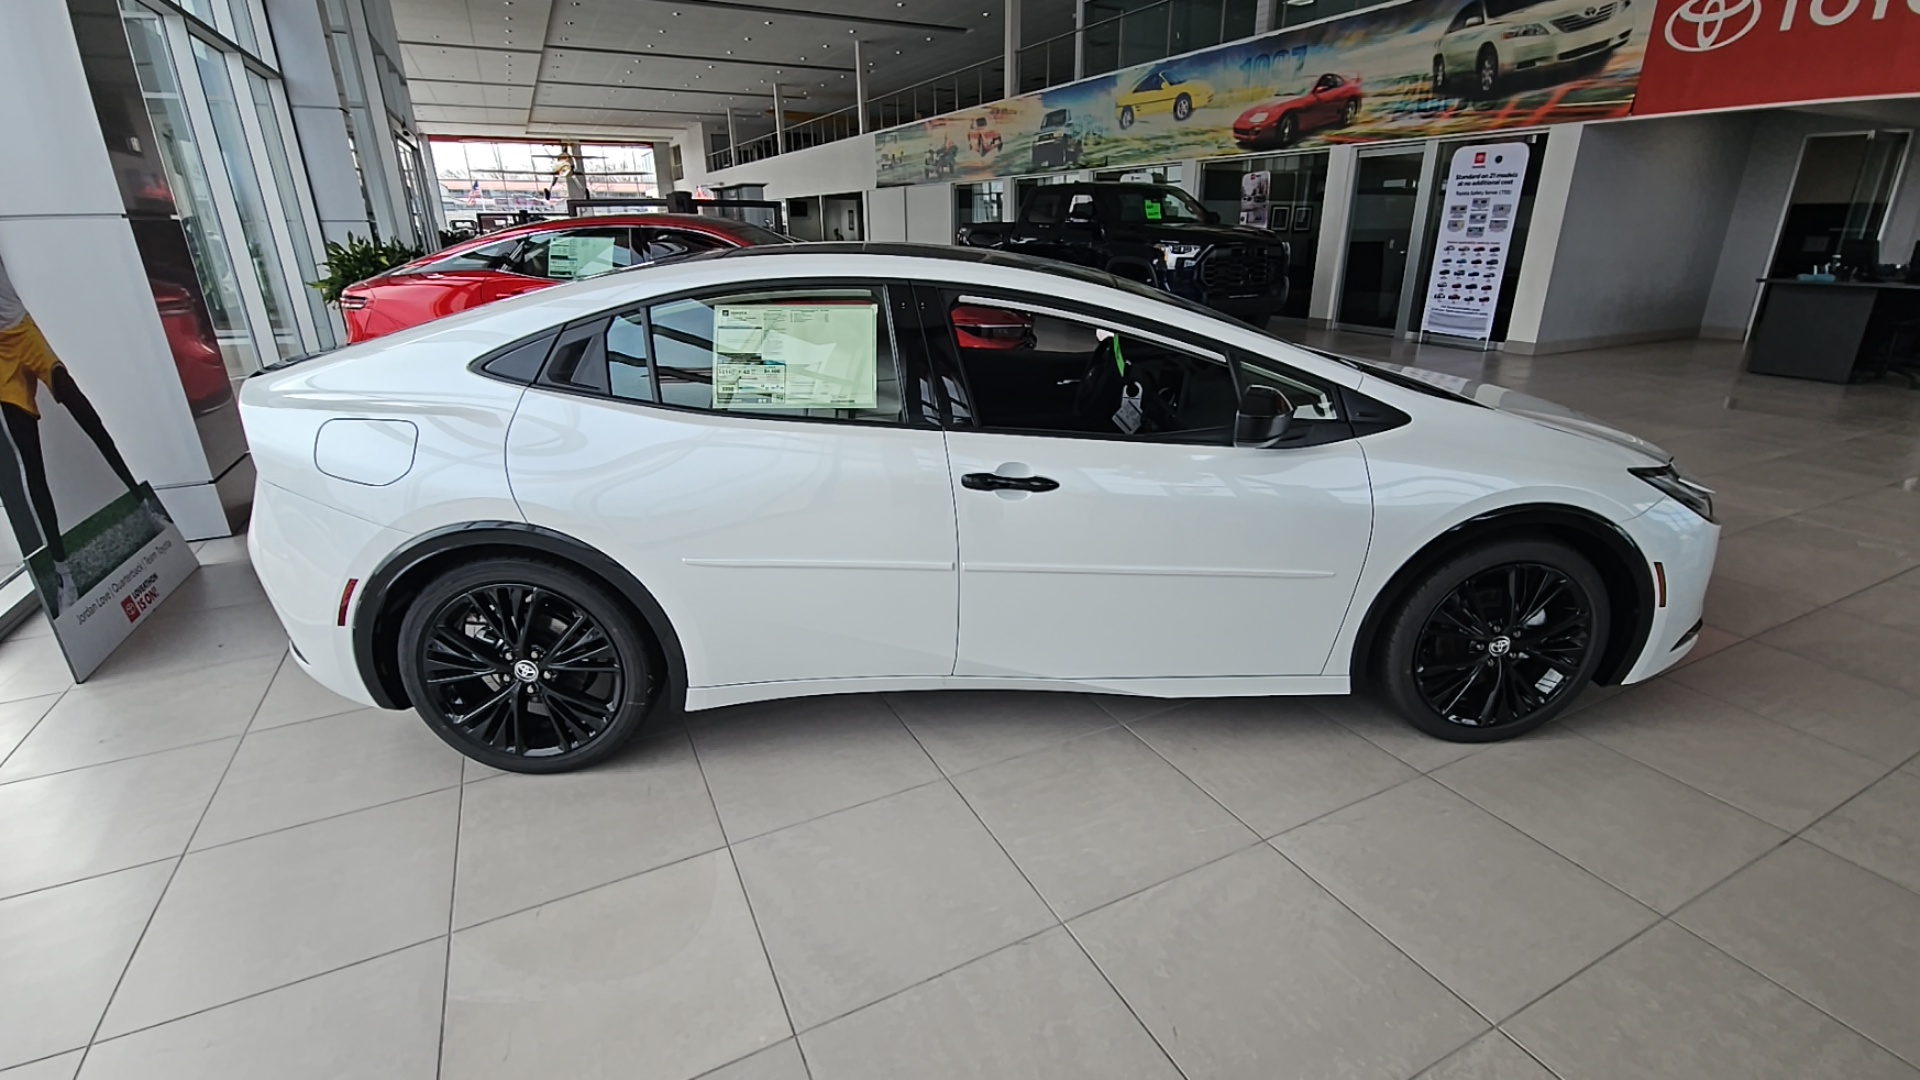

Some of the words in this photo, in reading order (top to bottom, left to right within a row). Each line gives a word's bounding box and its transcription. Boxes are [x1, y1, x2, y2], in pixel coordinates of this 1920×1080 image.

[76, 603, 98, 625] Jordan
[95, 592, 112, 608] Love
[111, 564, 144, 593] Quarterback
[143, 552, 157, 565] Team
[155, 540, 172, 555] Toyota
[131, 572, 159, 599] LOVEATHON
[137, 598, 147, 612] IS
[145, 586, 159, 605] ON!
